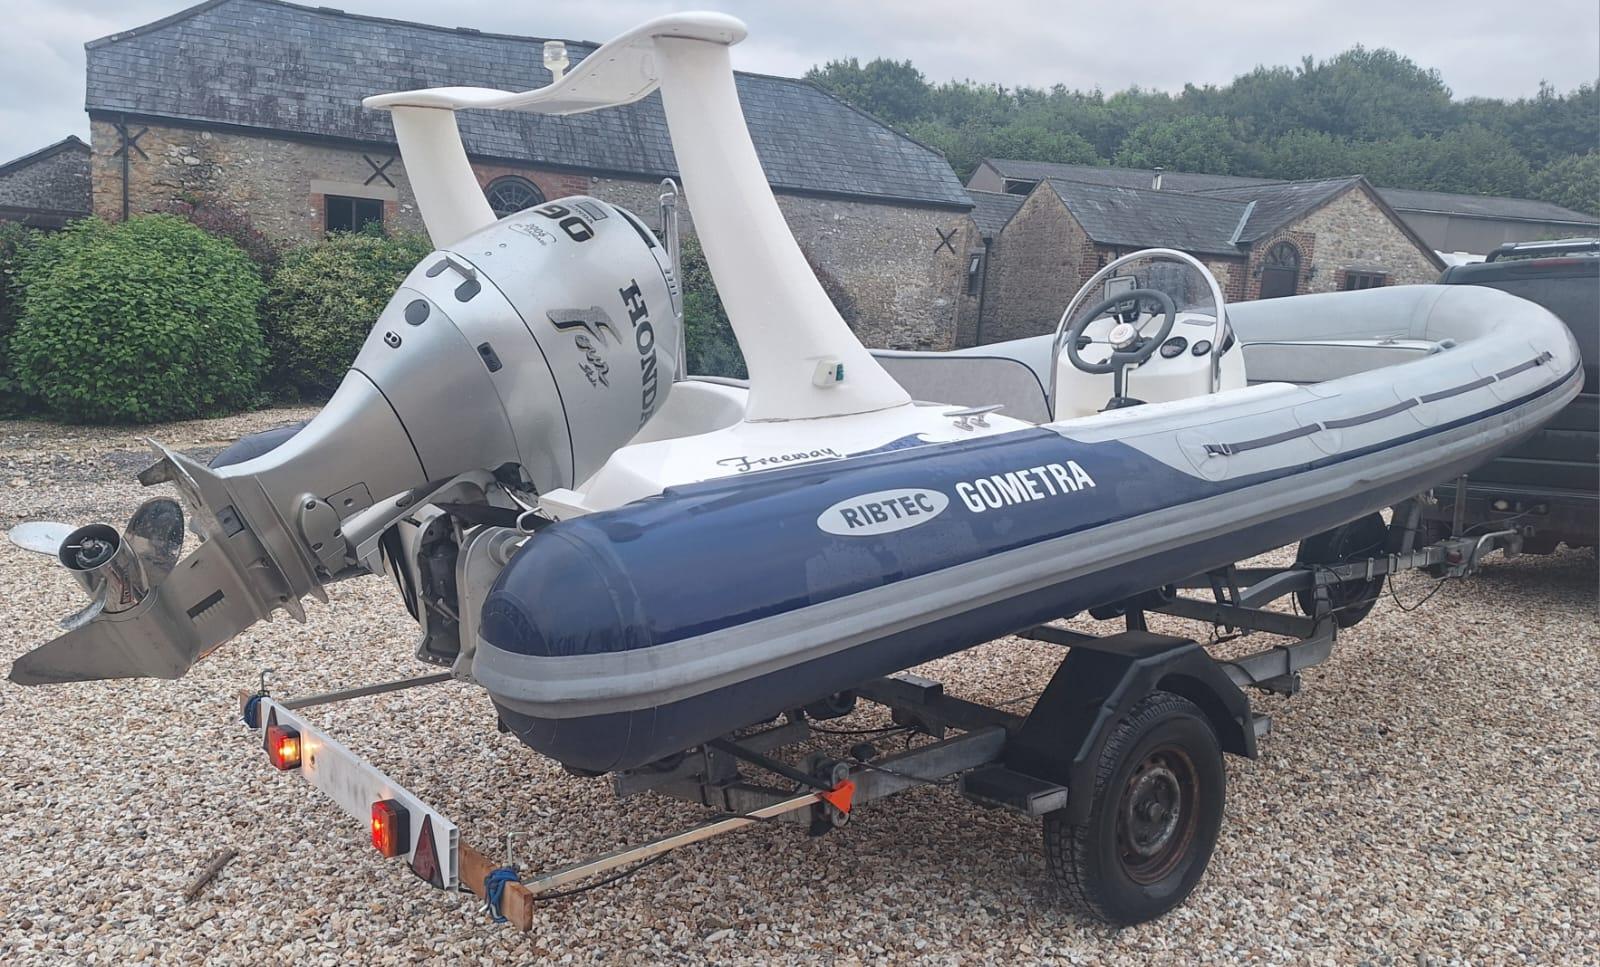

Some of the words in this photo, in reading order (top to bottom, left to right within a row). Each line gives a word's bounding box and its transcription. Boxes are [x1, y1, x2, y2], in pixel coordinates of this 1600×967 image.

[534, 204, 595, 243] 90
[716, 447, 842, 472] Freeway
[955, 460, 1097, 513] GOMETRA
[839, 492, 935, 529] RIBTEC
